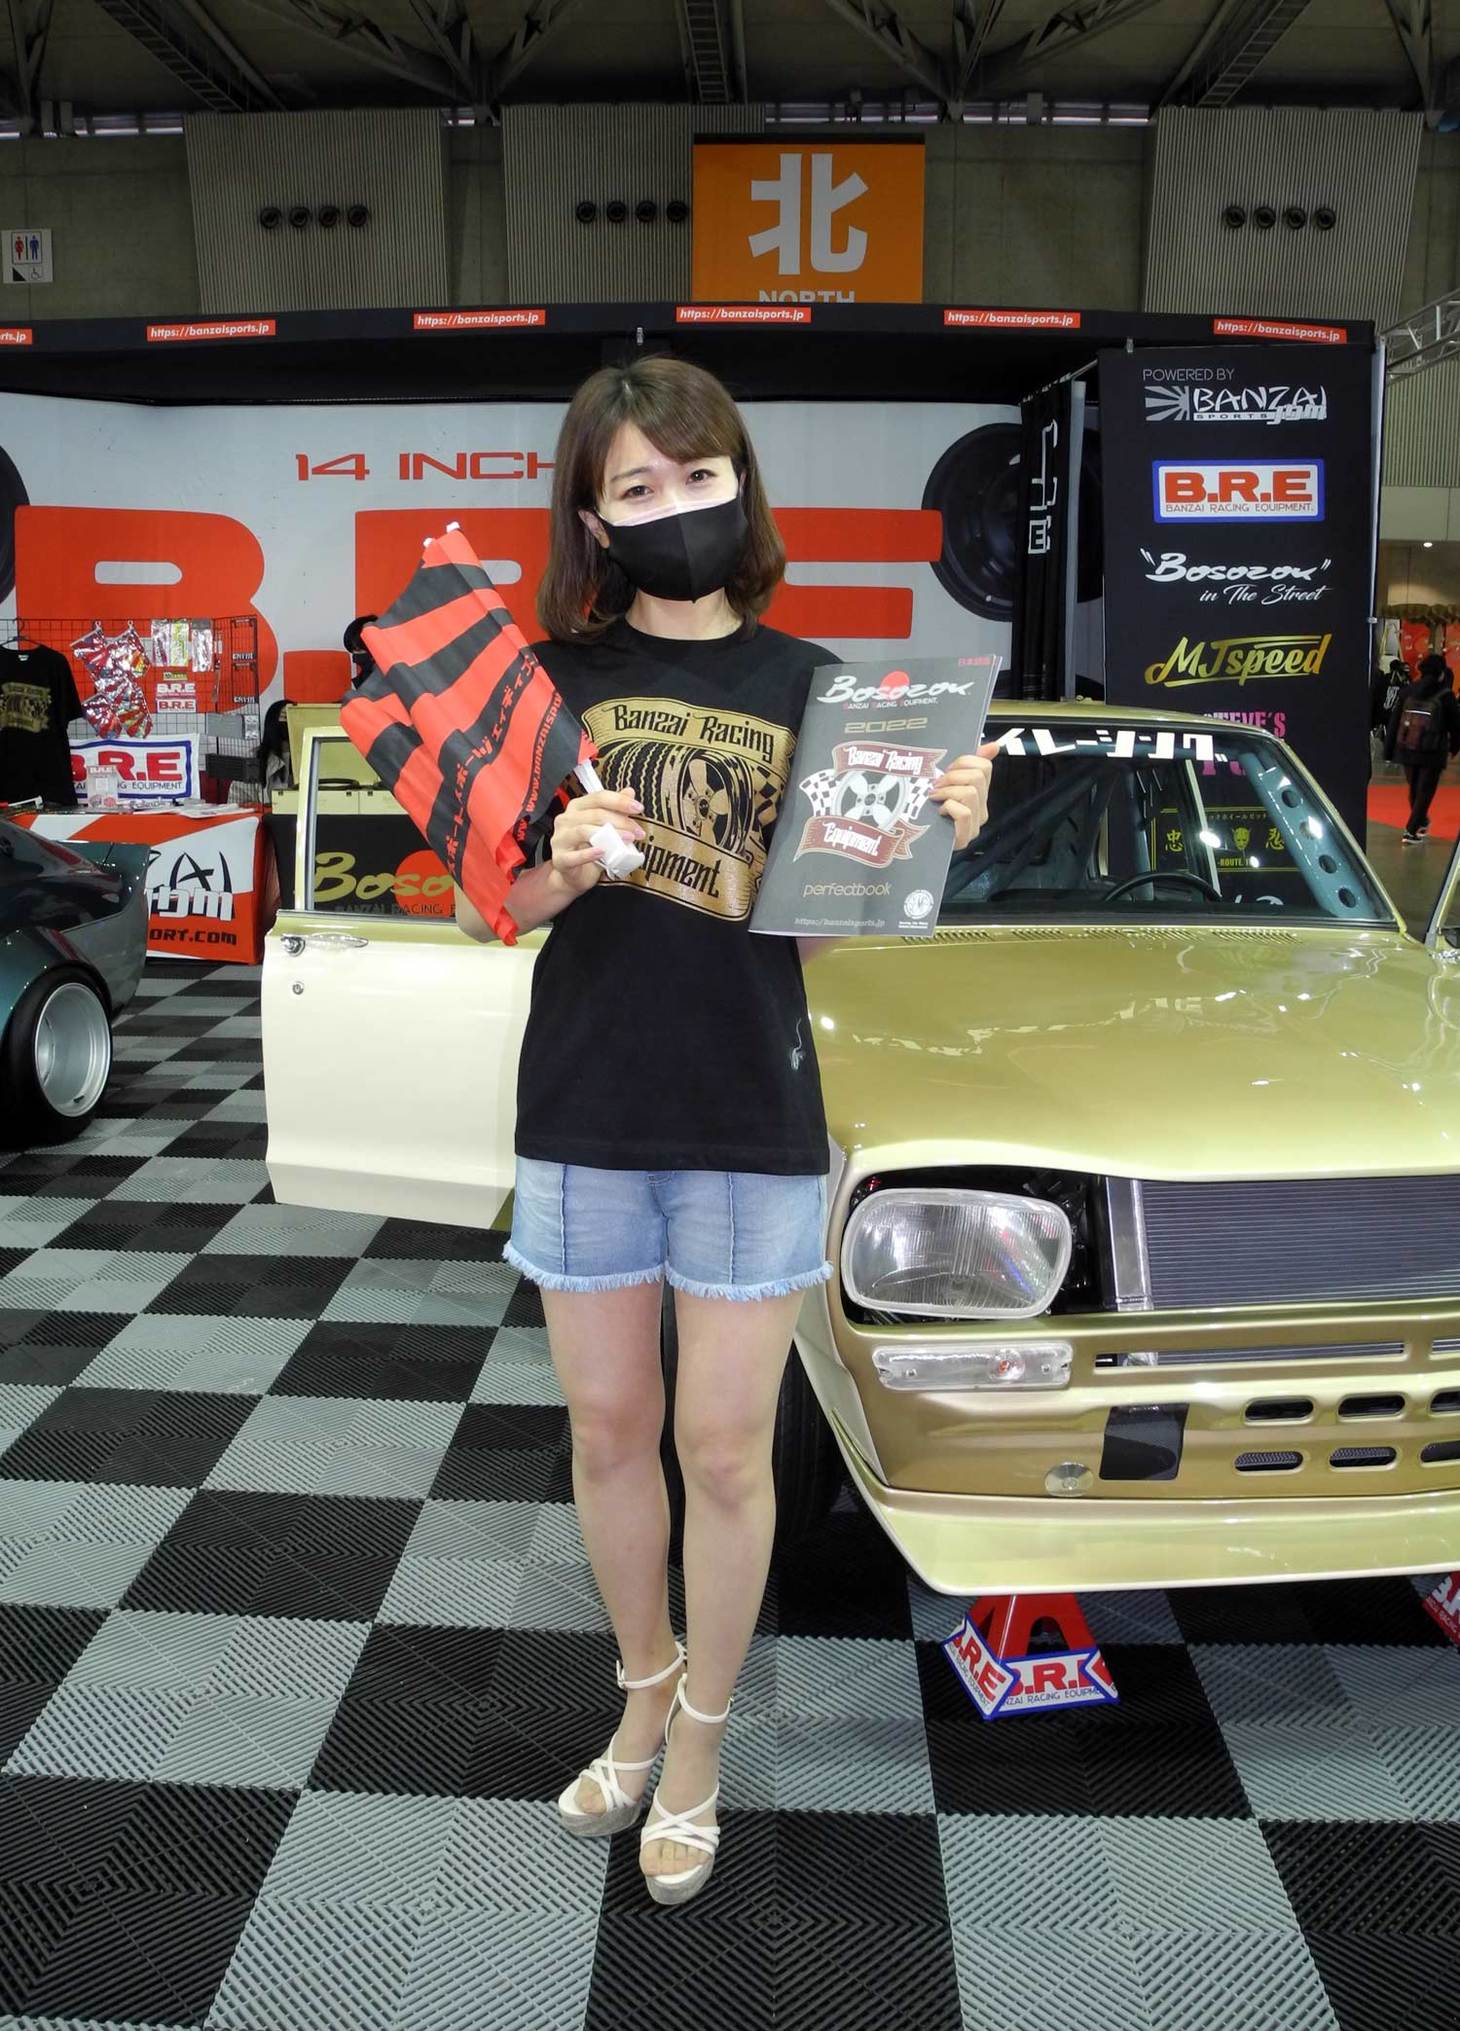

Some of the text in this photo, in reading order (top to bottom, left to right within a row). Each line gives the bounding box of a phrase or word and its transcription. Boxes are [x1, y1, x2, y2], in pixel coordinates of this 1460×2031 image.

[748, 153, 869, 275] 北
[758, 290, 856, 303] NORTH
[416, 311, 538, 326] https://banzaisports.jp
[679, 307, 805, 321] https://banzaisports.jp
[947, 311, 1073, 326] https://banzaisports.jp
[150, 322, 269, 340] https://banzaisports.jp
[1216, 321, 1341, 341] https://banzaisports.jp
[1142, 368, 1235, 381] POWERED BY
[1193, 385, 1328, 412] BANZAI
[295, 452, 371, 480] 14
[1164, 470, 1313, 503] B.R.E
[1165, 504, 1205, 513] BANZAI
[1209, 503, 1250, 513] RACING
[1199, 583, 1335, 605] in The Street
[158, 700, 194, 710] B.R.E
[602, 704, 775, 763] Banzai Racing
[844, 717, 928, 734] 2022
[844, 746, 924, 775] Banzai Racing
[822, 822, 882, 857] Equipment
[803, 882, 893, 899] perfectbook
[1027, 1693, 1061, 1704] RACING
